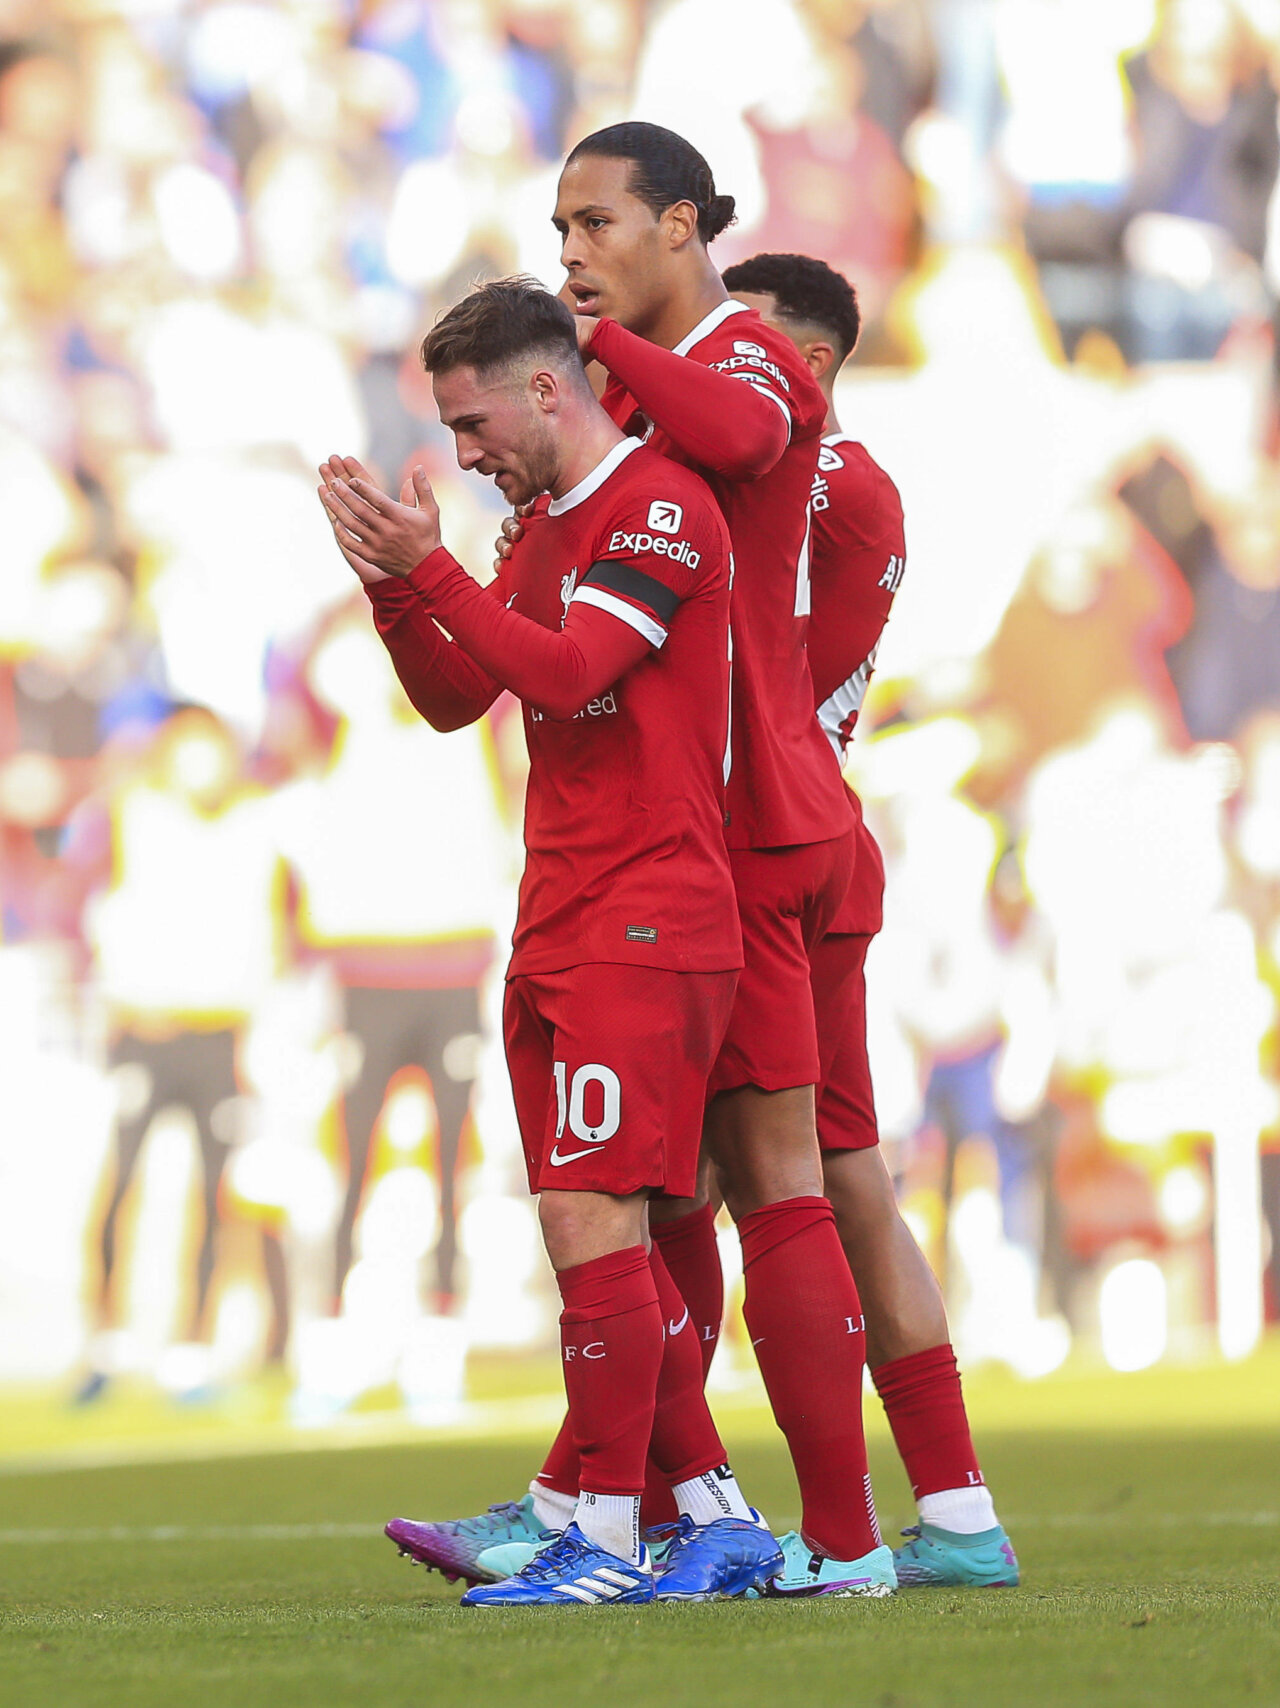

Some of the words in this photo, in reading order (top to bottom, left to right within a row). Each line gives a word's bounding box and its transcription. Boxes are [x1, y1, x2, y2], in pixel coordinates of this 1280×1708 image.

[708, 356, 790, 393] xpedia
[608, 530, 701, 570] Expedia
[553, 1061, 621, 1143] 10
